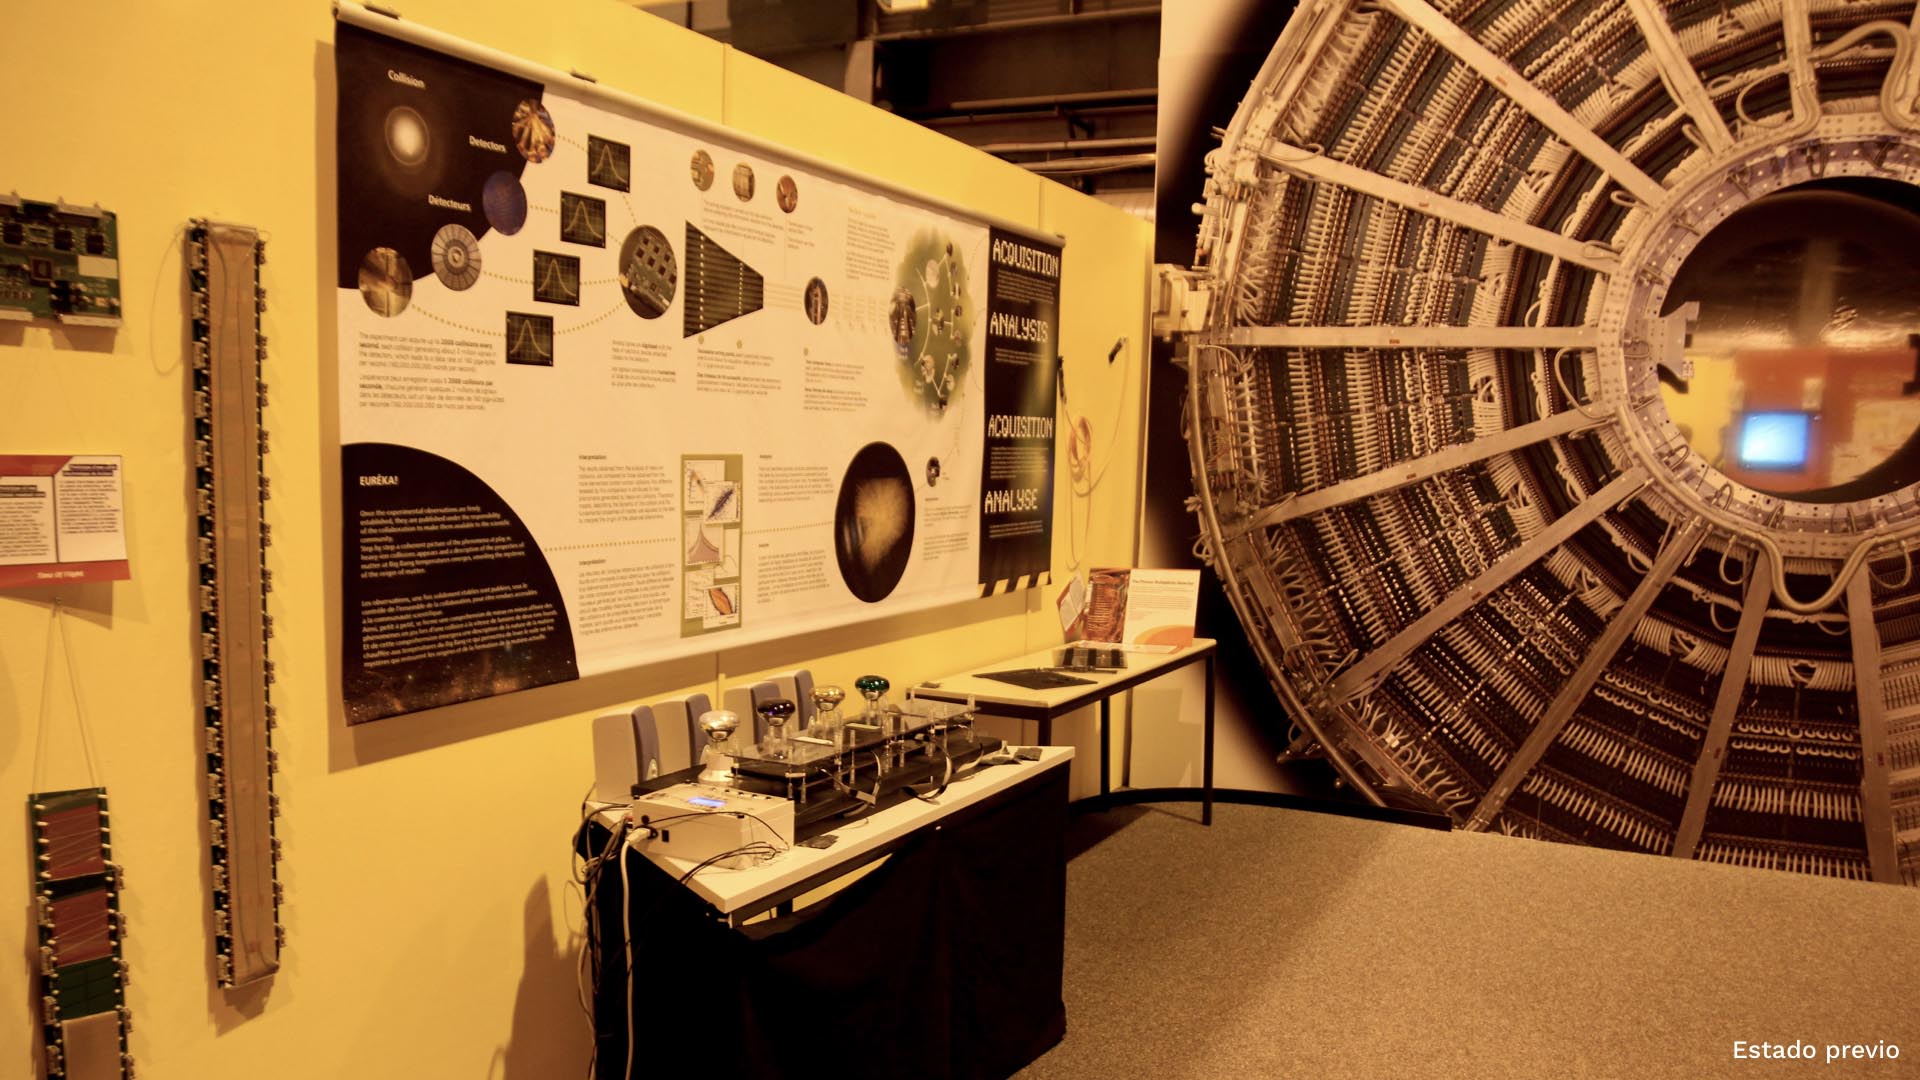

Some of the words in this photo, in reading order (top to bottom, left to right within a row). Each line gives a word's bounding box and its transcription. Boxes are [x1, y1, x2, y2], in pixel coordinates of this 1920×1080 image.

[388, 70, 426, 89] Collision
[469, 136, 508, 153] Detectors
[428, 194, 472, 212] Détecteurs
[992, 238, 1059, 277] ACQUISITION
[990, 312, 1049, 342] ANALYSIS
[988, 415, 1054, 439] ACQUISITION
[984, 489, 1038, 514] ANALYSE
